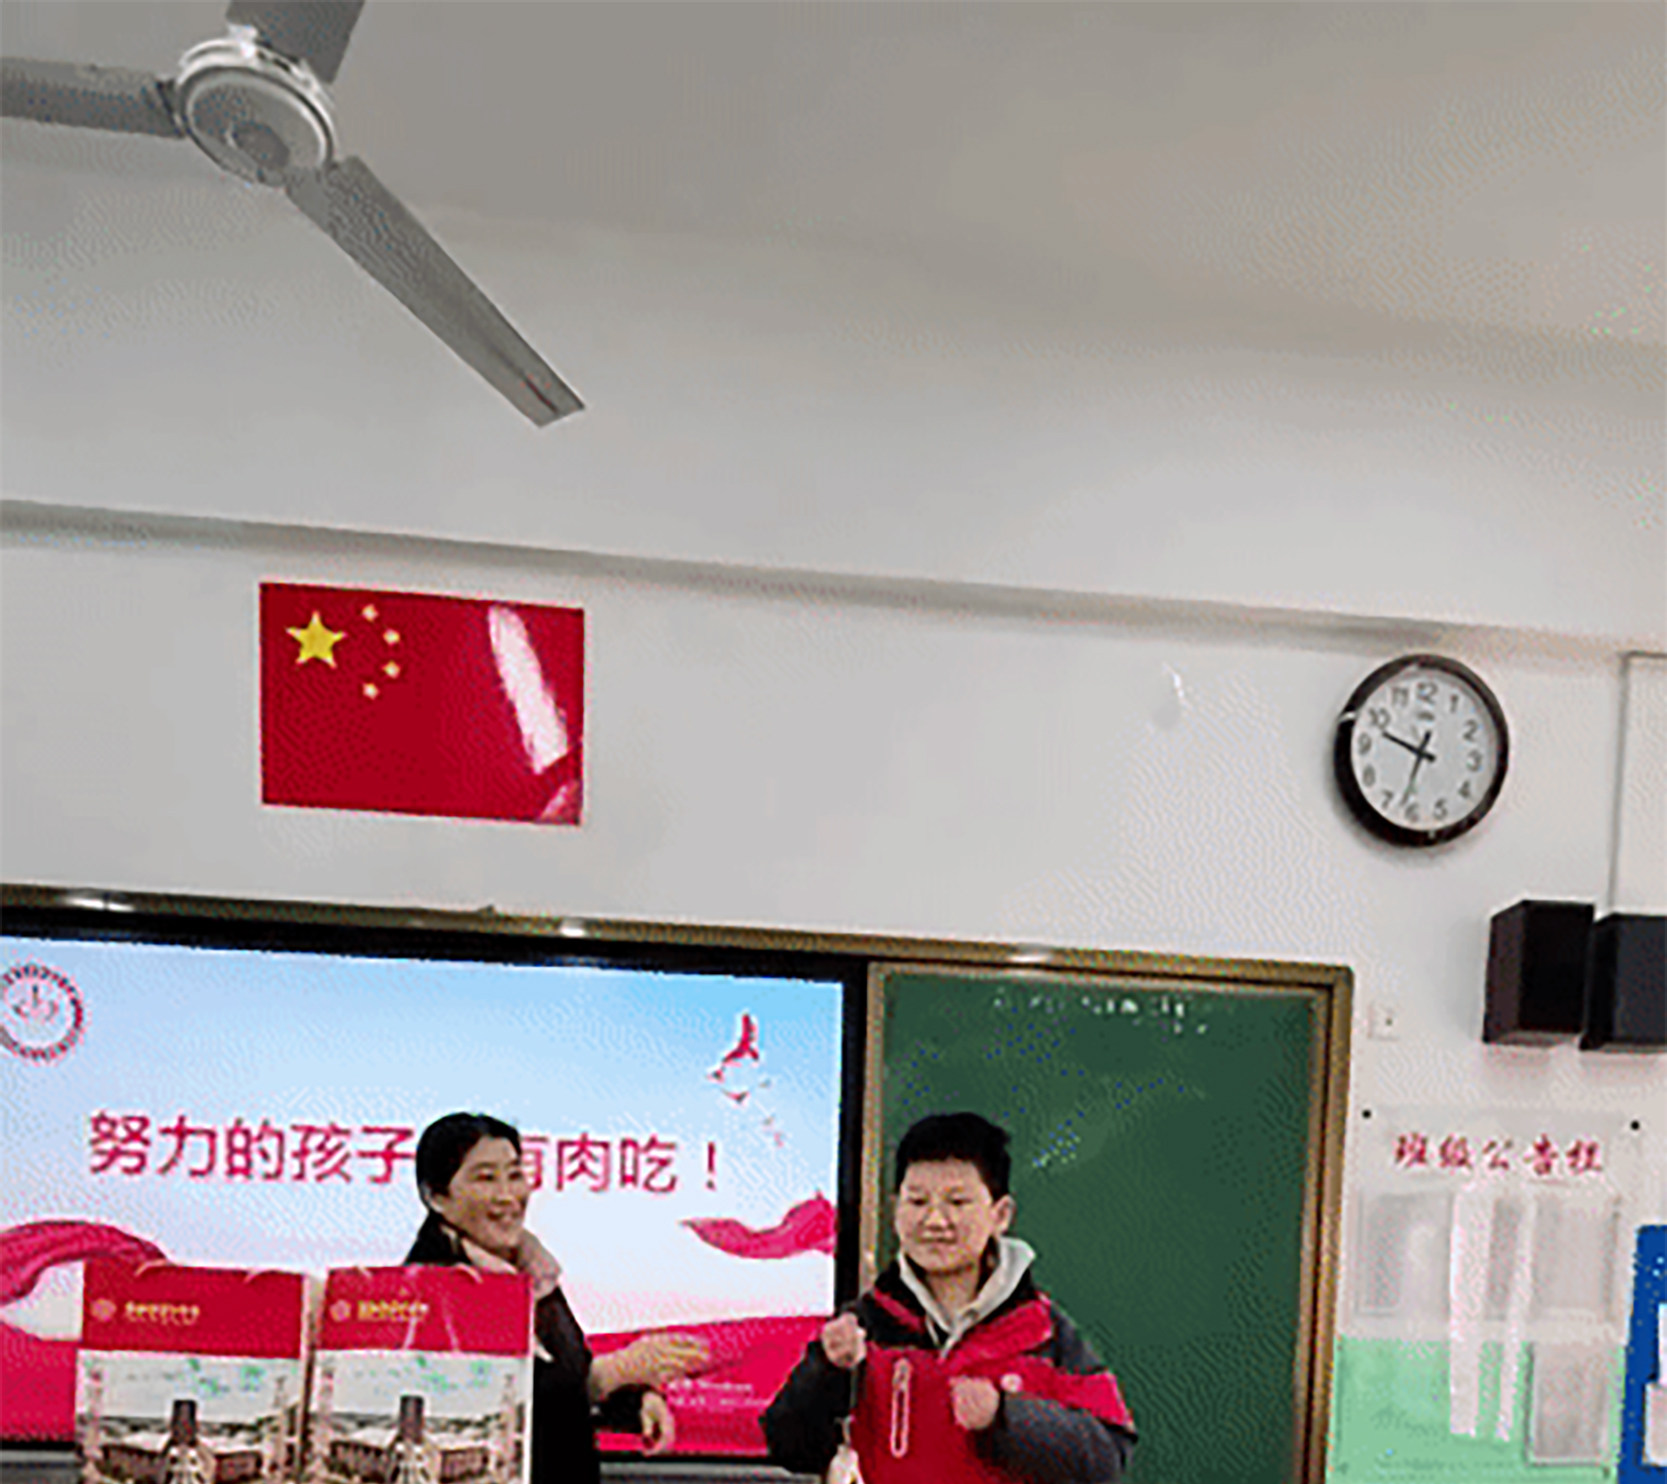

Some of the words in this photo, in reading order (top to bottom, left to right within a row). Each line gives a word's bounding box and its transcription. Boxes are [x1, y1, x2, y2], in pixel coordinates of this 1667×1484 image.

[1391, 687, 1409, 706] 11
[1417, 681, 1438, 704] 12
[1450, 694, 1459, 713] 1
[1368, 707, 1390, 729] 10
[1463, 719, 1479, 742] 2
[1358, 732, 1372, 755] 9
[1467, 750, 1483, 772] 3
[1381, 789, 1394, 809] 7
[1458, 780, 1472, 799] 4
[1404, 802, 1419, 823] 6
[1432, 799, 1448, 820] 5
[89, 1109, 717, 1194] 努力的孩子肉吃！
